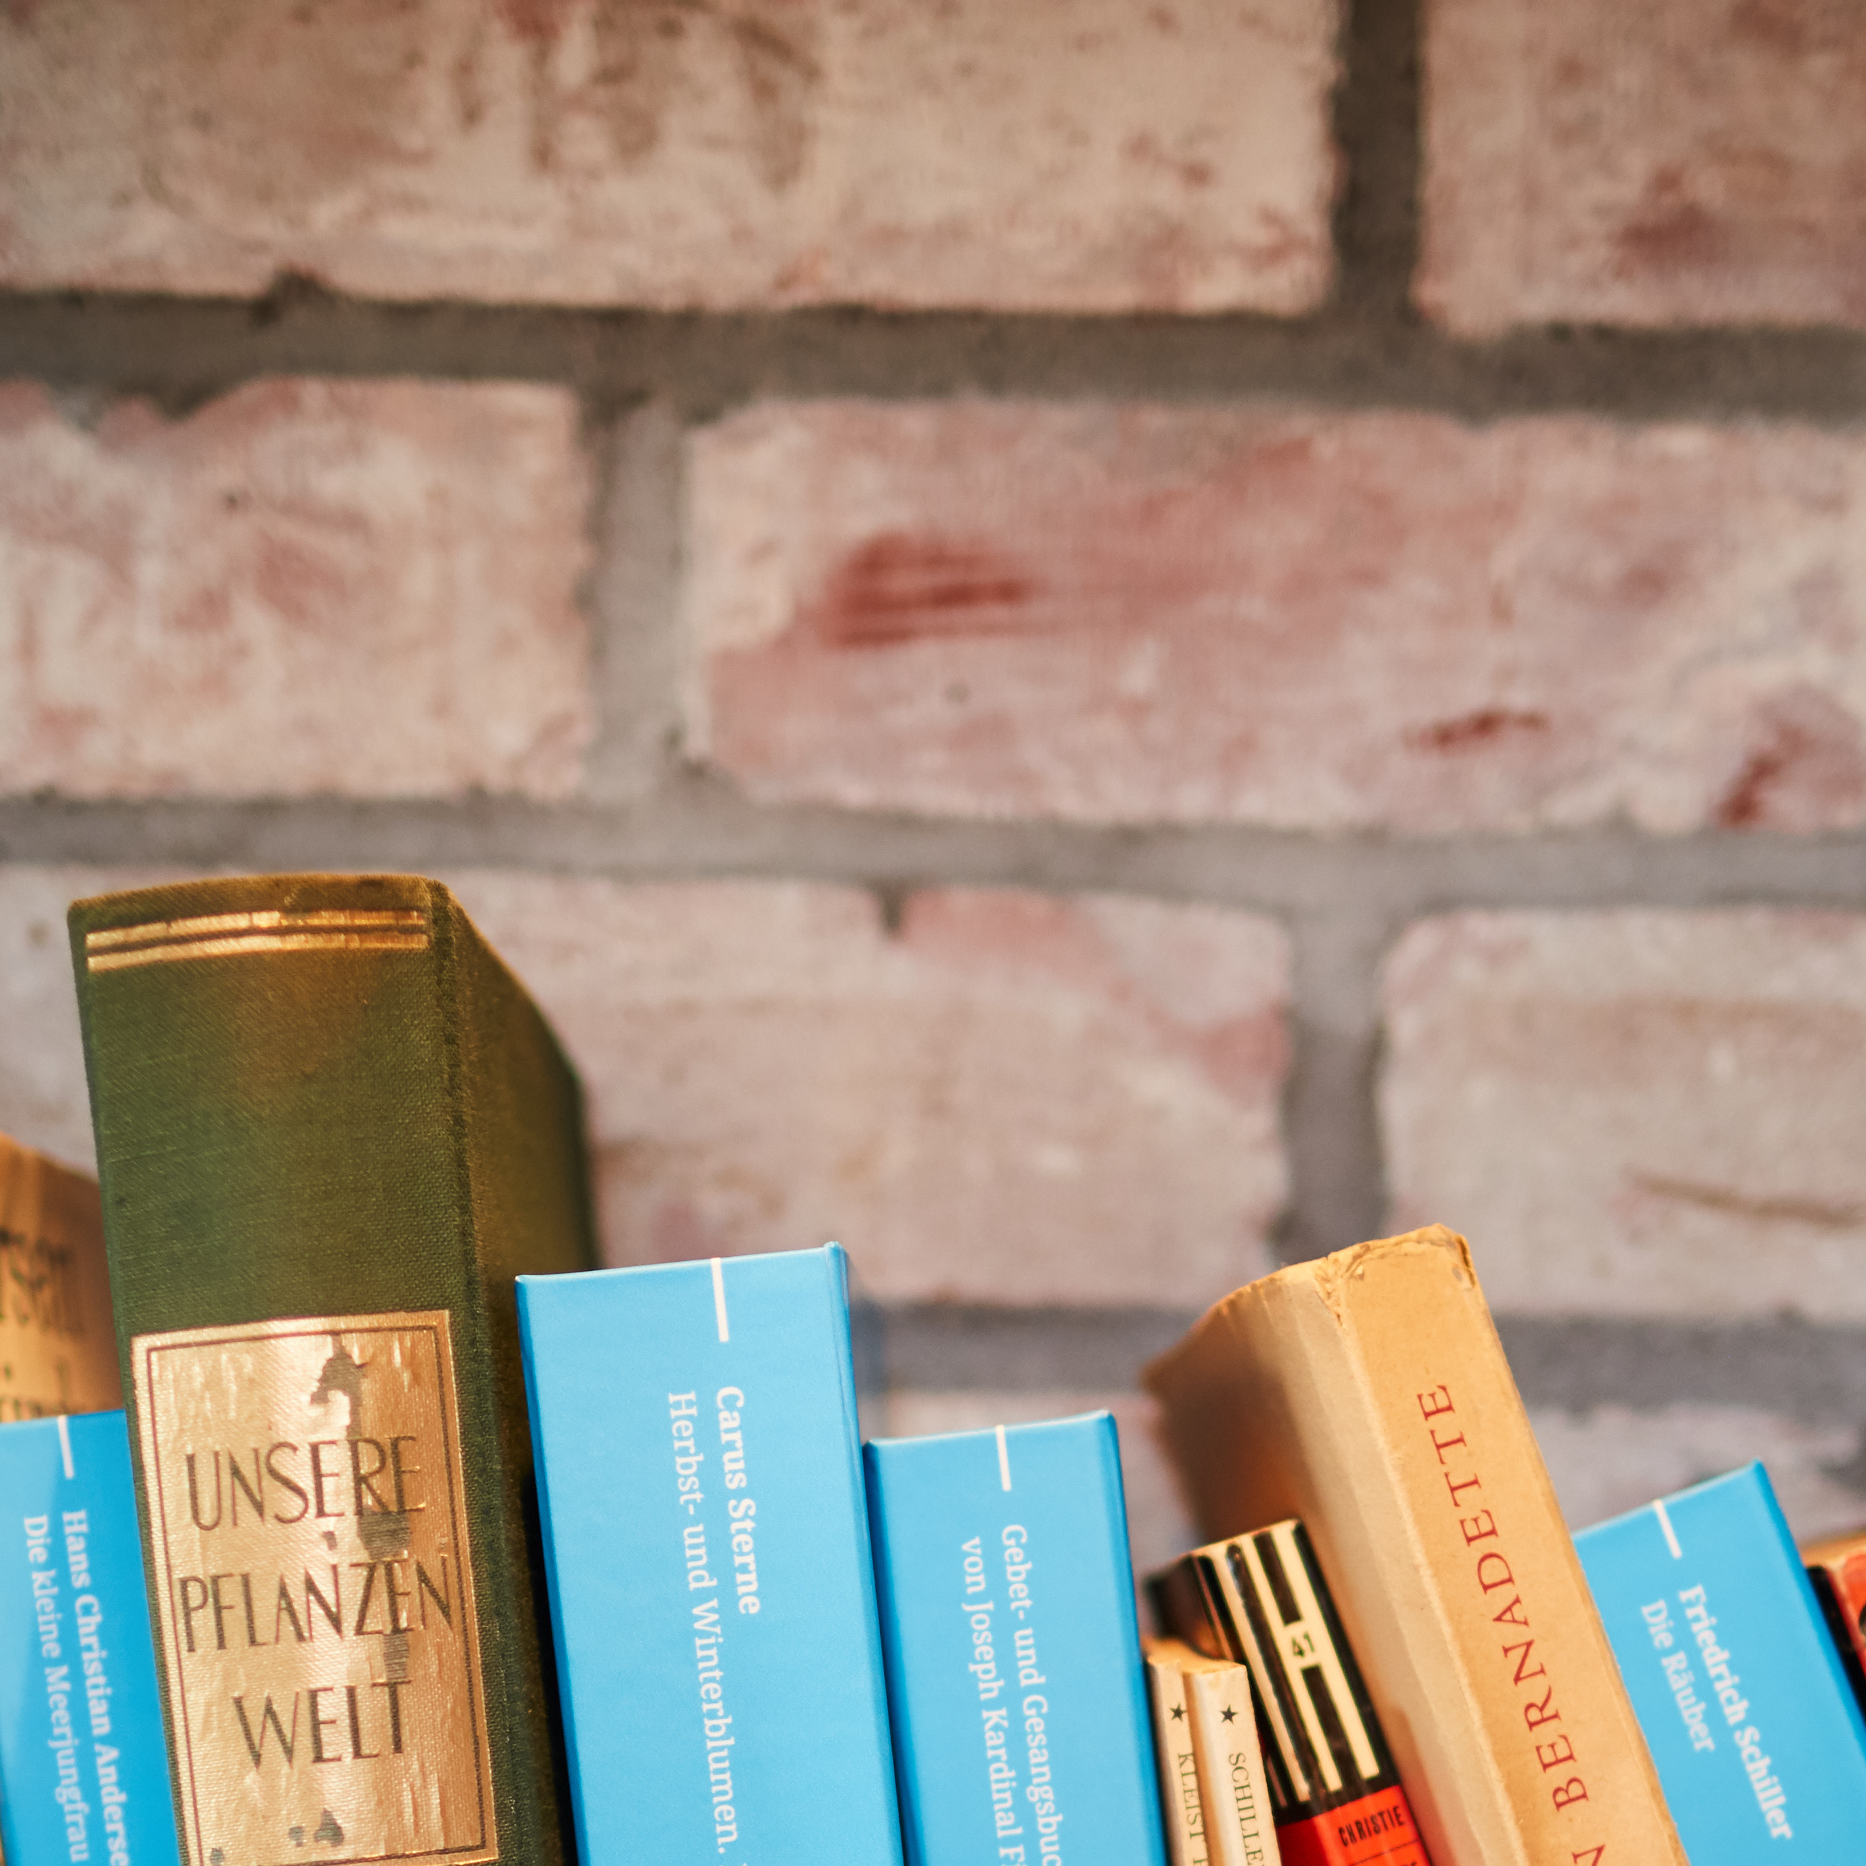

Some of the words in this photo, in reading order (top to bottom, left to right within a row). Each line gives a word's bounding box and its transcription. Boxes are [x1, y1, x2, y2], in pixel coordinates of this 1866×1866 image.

[185, 1436, 426, 1531] UNSERE
[668, 1390, 703, 1514] Herbst-
[715, 1386, 748, 1491] Carus
[23, 1515, 48, 1564] Die
[62, 1510, 90, 1589] Hans
[682, 1526, 716, 1592] und
[727, 1497, 762, 1616] Sterne
[961, 1536, 987, 1597] von
[1001, 1523, 1034, 1621] Gebet-
[31, 1567, 63, 1658] kleine
[179, 1557, 453, 1653] PFLANZEN
[1290, 1631, 1315, 1659] 41
[1416, 1382, 1590, 1813] BERNADETTE
[74, 1594, 113, 1737] Christian
[962, 1599, 1003, 1702] Joseph
[1013, 1627, 1047, 1688] und
[1641, 1599, 1677, 1650] Die
[1663, 1648, 1716, 1754] Räuber
[234, 1679, 412, 1769] WELT
[692, 1598, 745, 1855] Winterblumen.
[1678, 1584, 1747, 1728] Friedrich
[1733, 1722, 1795, 1841] Schiller
[44, 1665, 91, 1863] Meerjungfrau
[981, 1708, 1024, 1840] Kardinal
[1177, 1751, 1207, 1841] KLEIST
[1338, 1805, 1405, 1848] CHRISTIE
